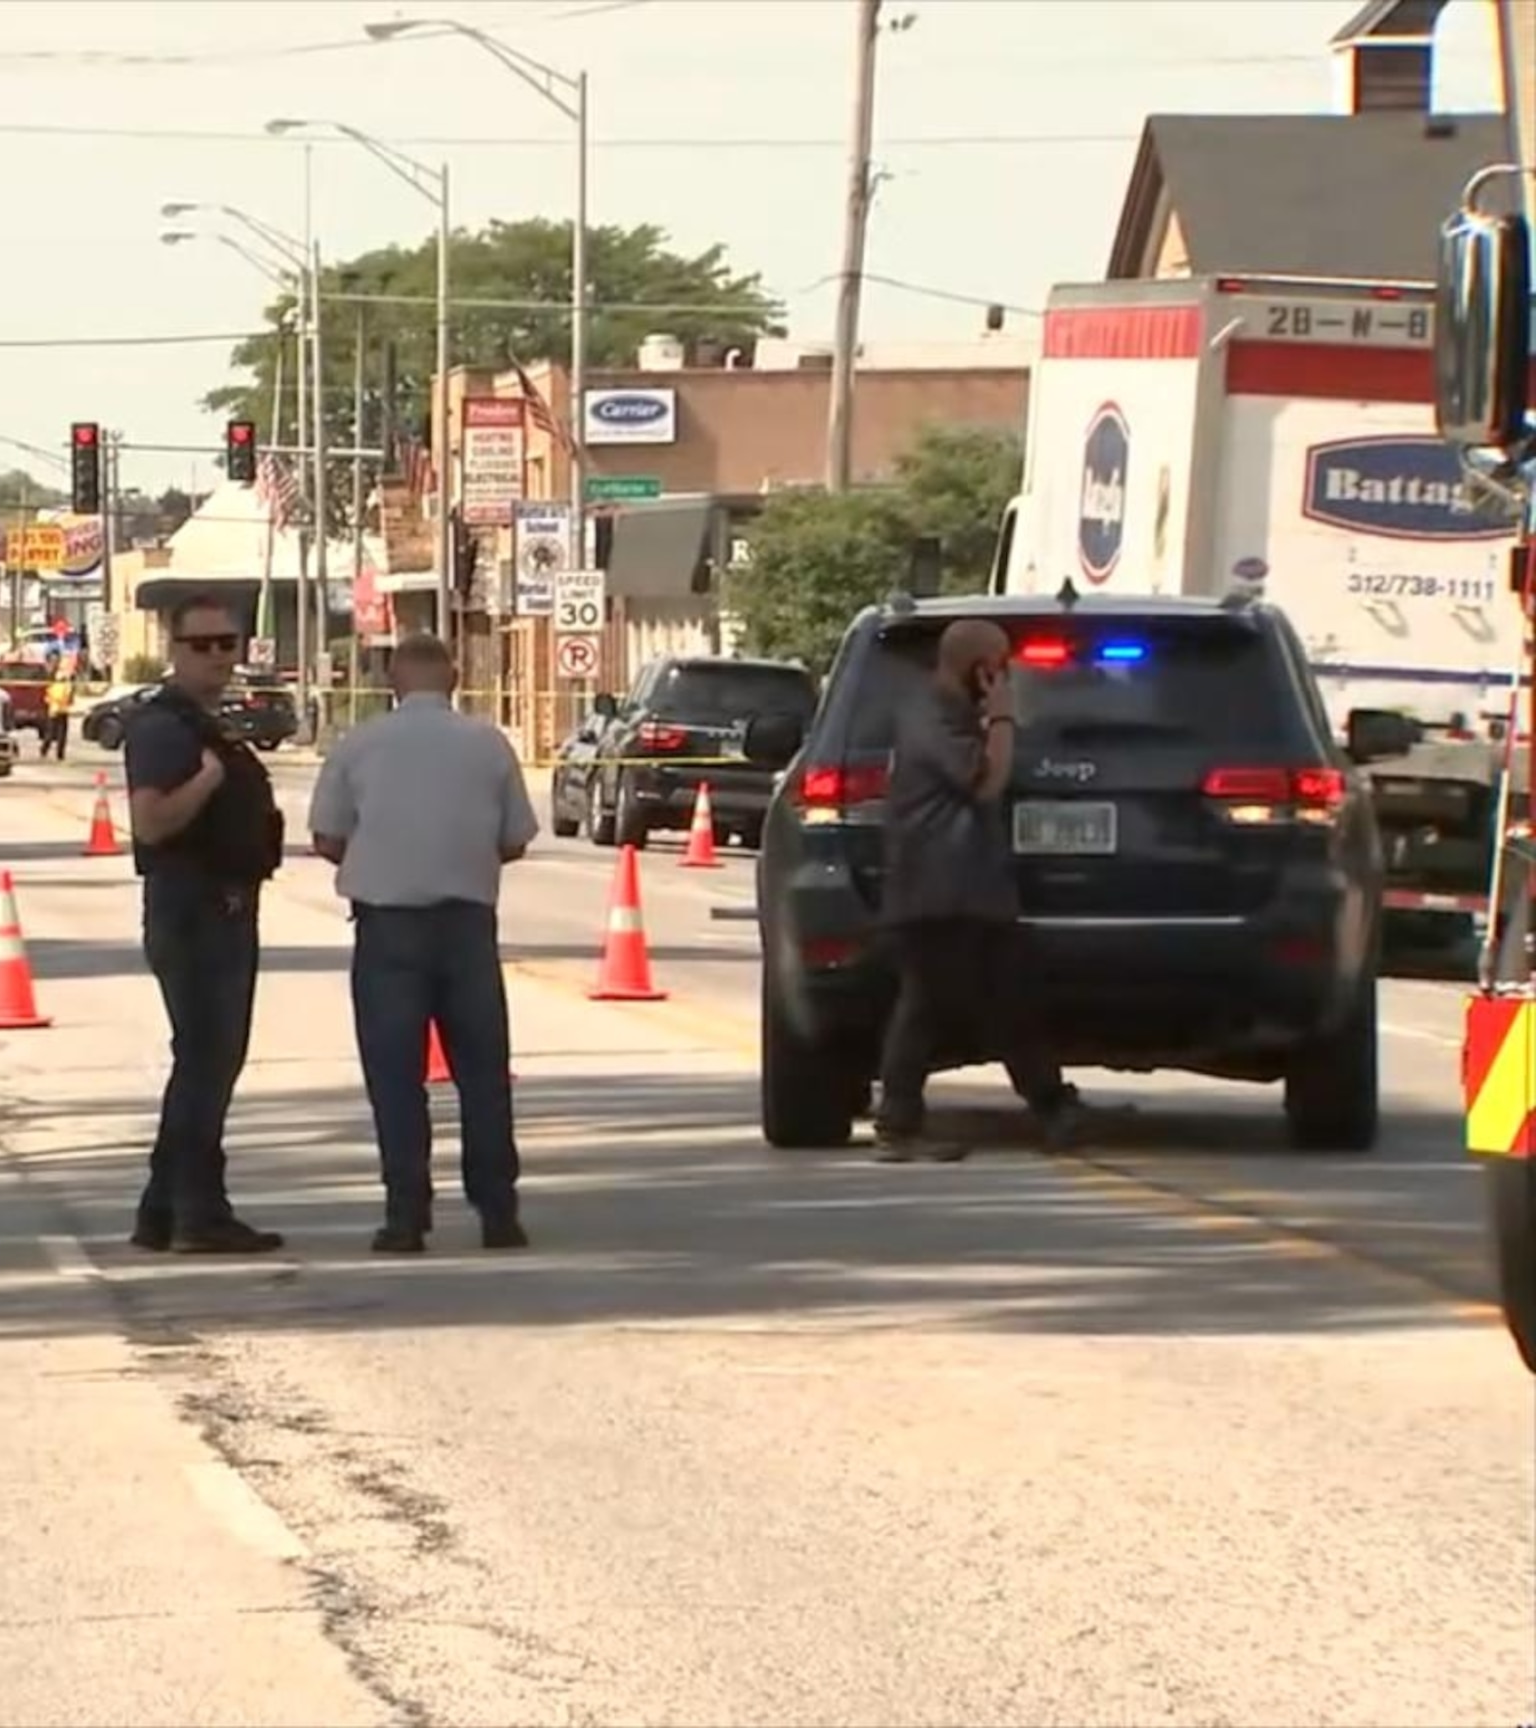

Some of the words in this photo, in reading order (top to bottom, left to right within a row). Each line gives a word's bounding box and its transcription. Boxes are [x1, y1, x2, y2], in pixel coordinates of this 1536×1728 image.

[599, 402, 661, 417] Carrier
[1326, 467, 1474, 515] Battag
[558, 575, 600, 587] SPEED
[1347, 574, 1494, 600] 312/738-1111
[561, 588, 595, 600] LIMIT
[560, 603, 599, 626] 30
[1033, 757, 1096, 781] Jeep
